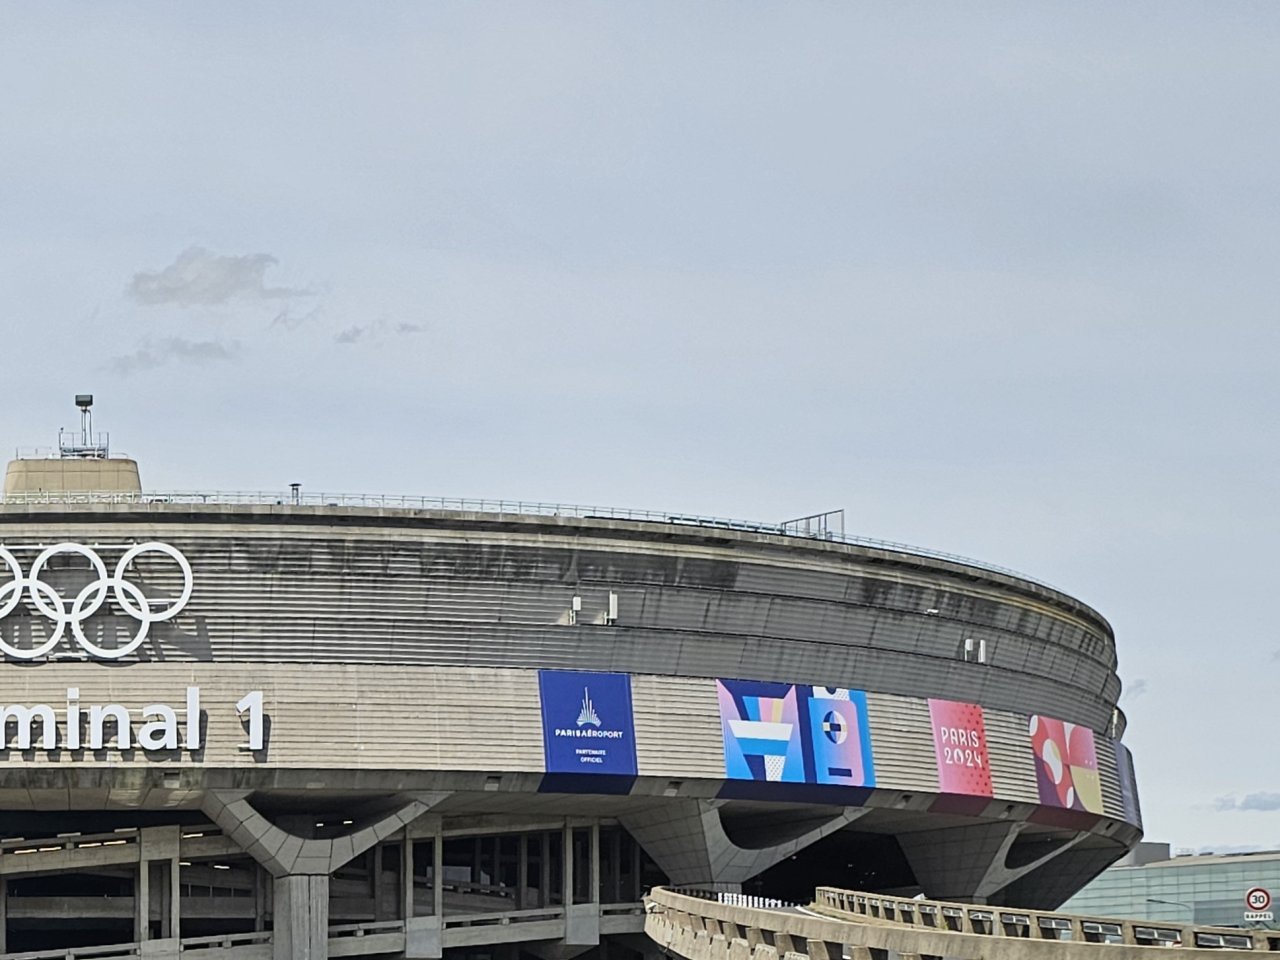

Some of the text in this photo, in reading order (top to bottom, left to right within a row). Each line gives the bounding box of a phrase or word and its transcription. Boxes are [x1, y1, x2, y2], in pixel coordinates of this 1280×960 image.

[236, 690, 263, 750] 1
[941, 727, 979, 748] PARIS
[944, 748, 982, 768] 2024
[1251, 895, 1265, 904] 30
